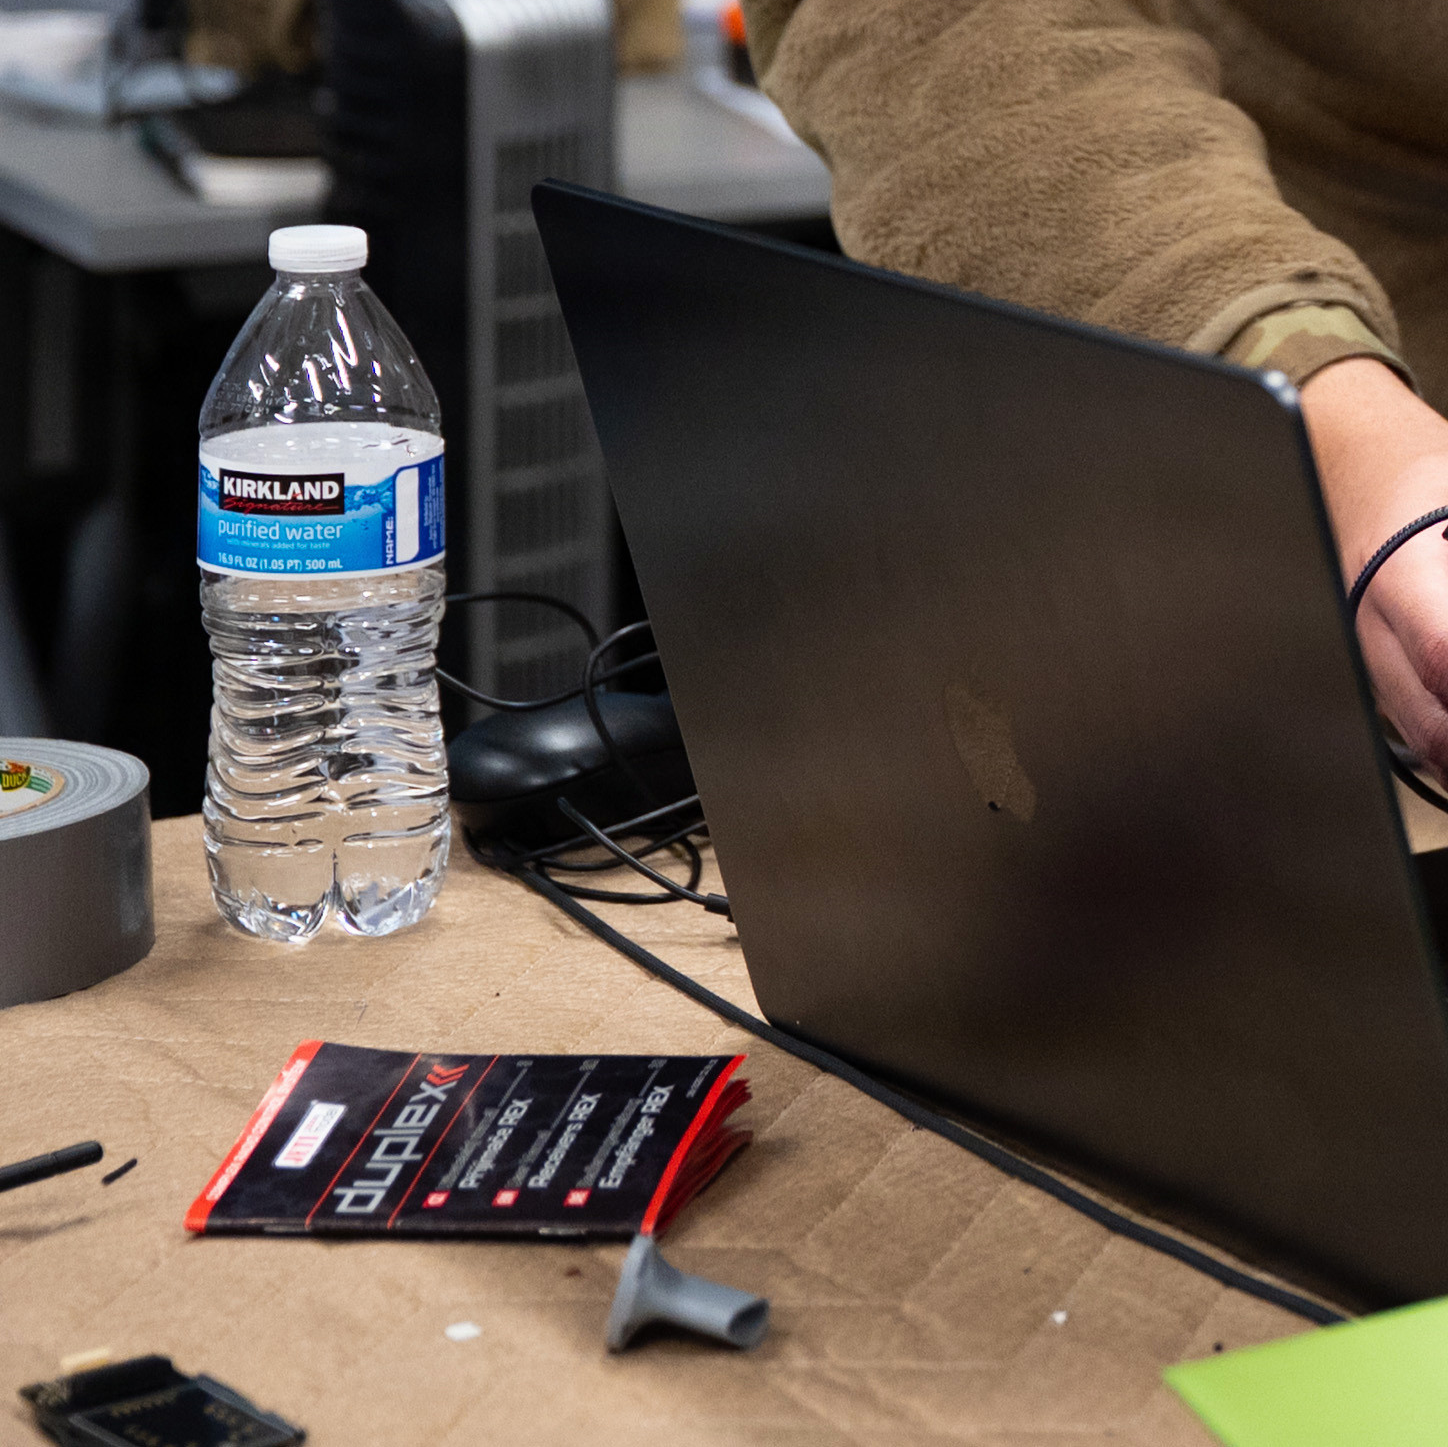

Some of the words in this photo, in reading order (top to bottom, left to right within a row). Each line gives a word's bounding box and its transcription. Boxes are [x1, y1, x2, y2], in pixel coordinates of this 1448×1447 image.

[223, 476, 340, 500] KIRKLAND
[223, 497, 340, 515] Signature
[218, 519, 280, 540] purified
[285, 524, 343, 540] water
[385, 516, 394, 565] NAME:
[242, 540, 270, 549] minerals
[272, 541, 295, 549] added
[310, 541, 331, 549] taste
[218, 552, 234, 565] 16.9
[234, 555, 244, 567] FL
[246, 556, 258, 568] OZ
[259, 557, 285, 570] (1.05
[286, 557, 303, 570] PT)
[305, 558, 326, 570] 500
[328, 558, 343, 569] mL
[498, 1098, 534, 1126] REX
[568, 1093, 603, 1122] REX
[641, 1084, 676, 1113] REX
[283, 1135, 319, 1164] JETI
[334, 1080, 458, 1215] duplex
